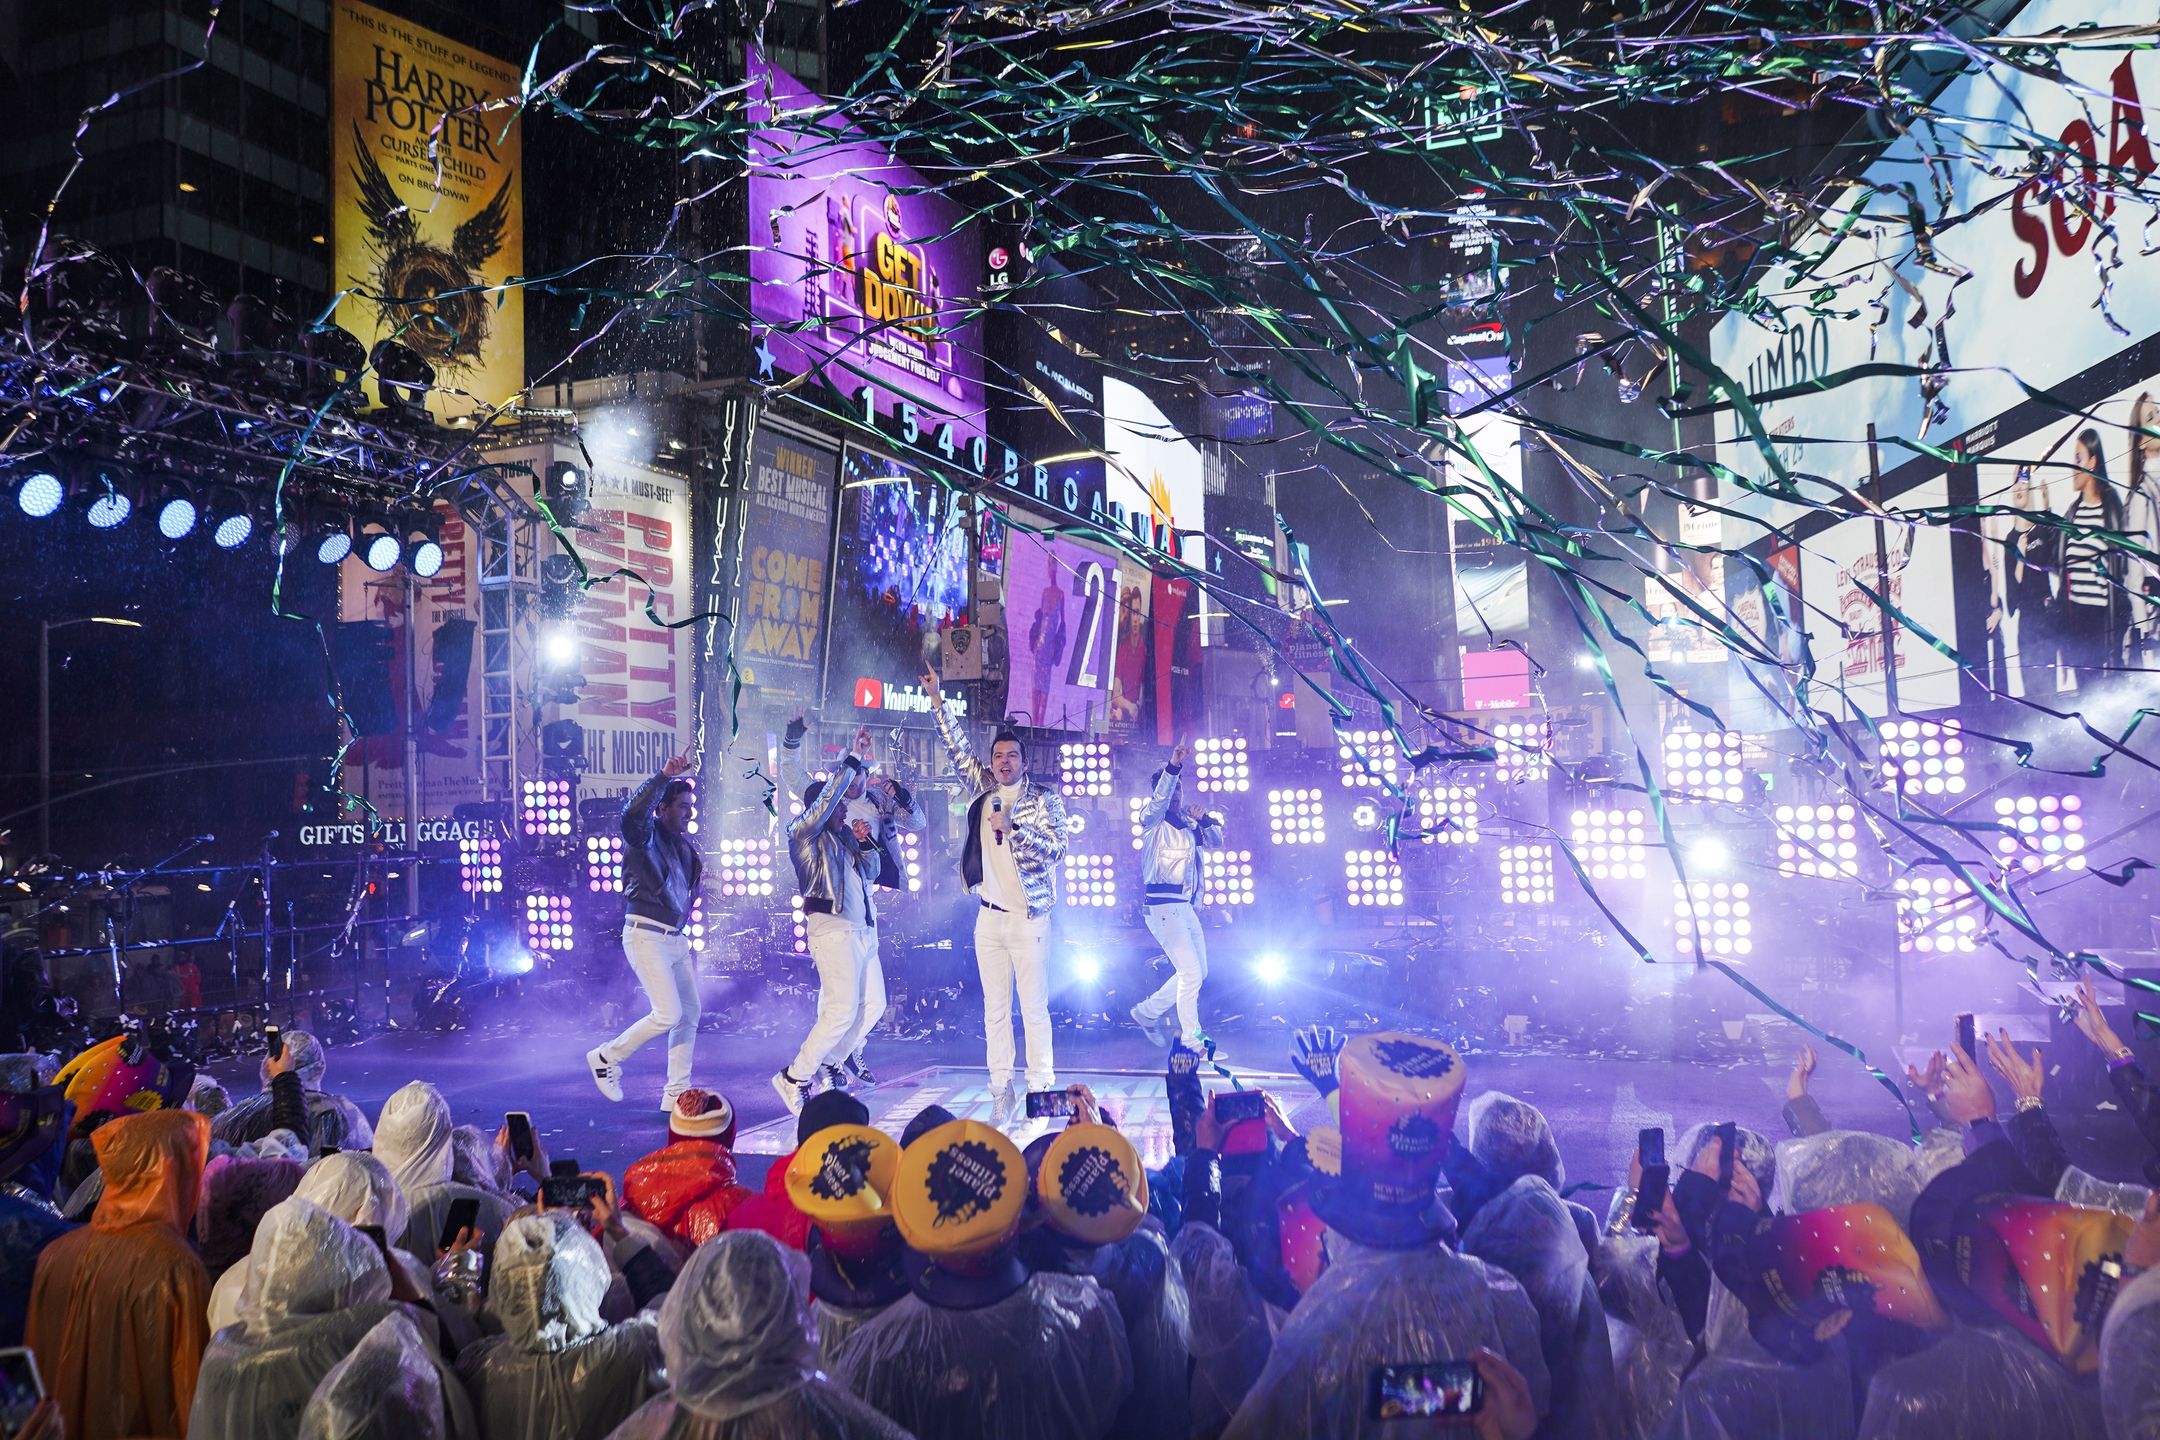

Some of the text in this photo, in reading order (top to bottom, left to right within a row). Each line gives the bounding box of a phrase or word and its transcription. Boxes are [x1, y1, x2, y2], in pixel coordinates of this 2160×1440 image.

[377, 21, 388, 34] IS
[392, 26, 414, 45] THE
[416, 37, 449, 58] STUFF
[452, 52, 467, 66] OF
[372, 43, 492, 124] HARRY
[364, 78, 500, 163] POTTER
[436, 144, 453, 156] THE
[442, 156, 486, 181] CHILD
[395, 156, 418, 169] PARTS
[419, 163, 434, 174] ONE
[454, 176, 472, 187] TWO
[398, 173, 470, 203] ON BROADWAY
[876, 231, 923, 293] GET
[1450, 241, 1464, 249] NEW
[1465, 246, 1483, 256] 2019
[990, 271, 1008, 286] LG
[869, 342, 940, 384] JUDGEMENT FREE SELF
[1966, 420, 1999, 445] MARRIOTT
[623, 479, 628, 493] A
[758, 465, 828, 511] BEST MUSICAL
[861, 386, 1188, 560] 1540 BROADWAY
[756, 493, 766, 507] ALL
[805, 507, 828, 524] AMERICA
[752, 545, 823, 594] COME
[575, 507, 629, 718] WOMAN
[627, 511, 678, 729] PRETTY
[748, 581, 821, 628] FROM
[743, 618, 818, 661] AWAY
[1076, 561, 1124, 691] 21
[1289, 641, 1322, 653] planet
[1293, 649, 1328, 660] fitness
[884, 682, 932, 714] YouTube
[300, 819, 496, 846] GIFTS LGGAG
[825, 1153, 850, 1182] planet
[949, 1162, 996, 1198] planet
[950, 1146, 996, 1185] fitness
[1063, 1154, 1098, 1197] fitness
[1077, 1154, 1109, 1198] planet
